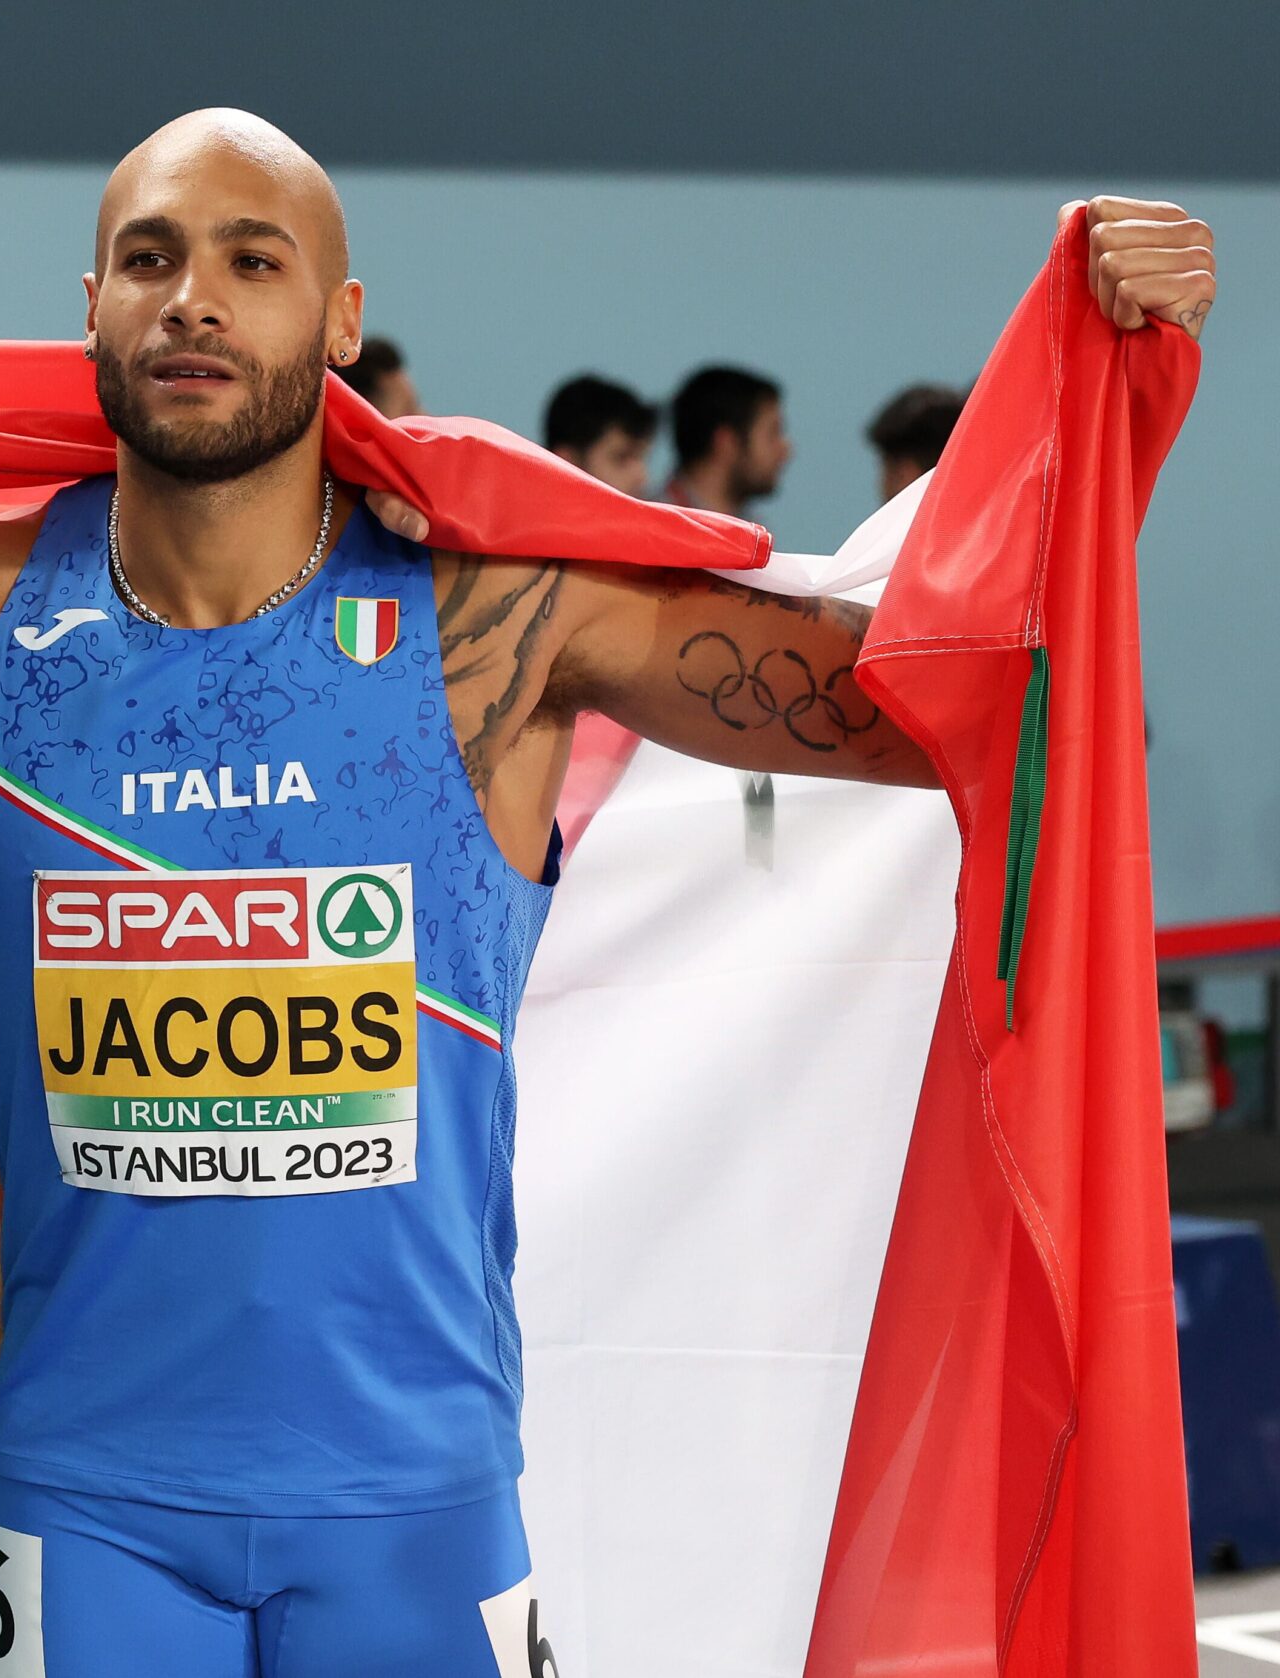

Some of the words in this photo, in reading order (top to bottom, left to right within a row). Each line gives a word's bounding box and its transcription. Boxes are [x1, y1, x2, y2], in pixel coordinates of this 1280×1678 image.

[122, 761, 317, 816] ITALIA
[46, 891, 300, 949] SPAR
[48, 991, 402, 1078] JACOBS
[113, 1101, 120, 1126] I
[131, 1100, 201, 1127] RUN
[73, 1142, 276, 1183] ISTANBUL
[285, 1138, 394, 1181] 2023
